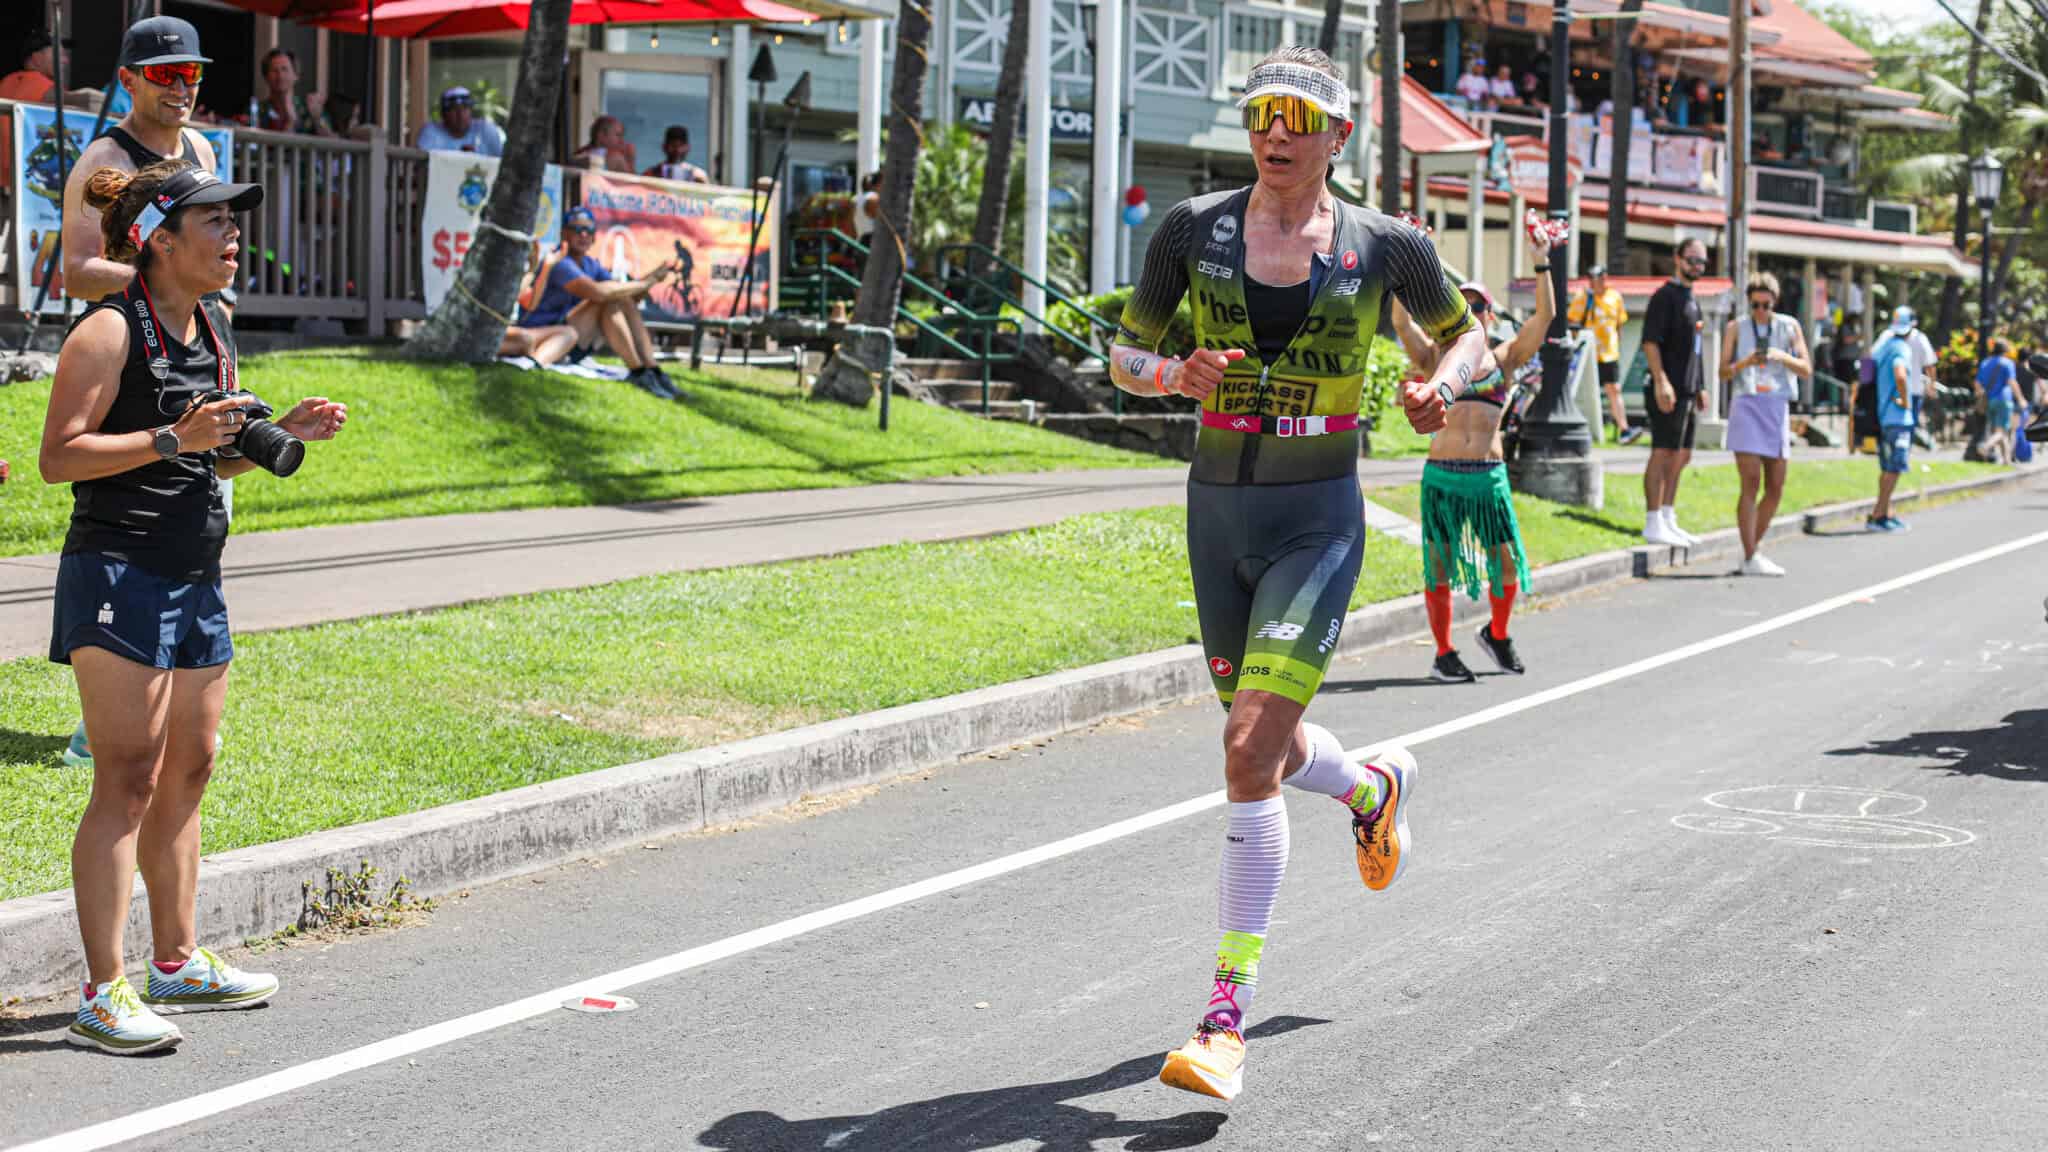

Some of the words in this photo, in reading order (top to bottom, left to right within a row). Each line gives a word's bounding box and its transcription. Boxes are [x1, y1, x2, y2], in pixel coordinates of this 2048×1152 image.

[964, 101, 996, 124] AB
[135, 299, 149, 318] 80D
[142, 320, 158, 347] EOS
[1224, 397, 1302, 415] SPORTS
